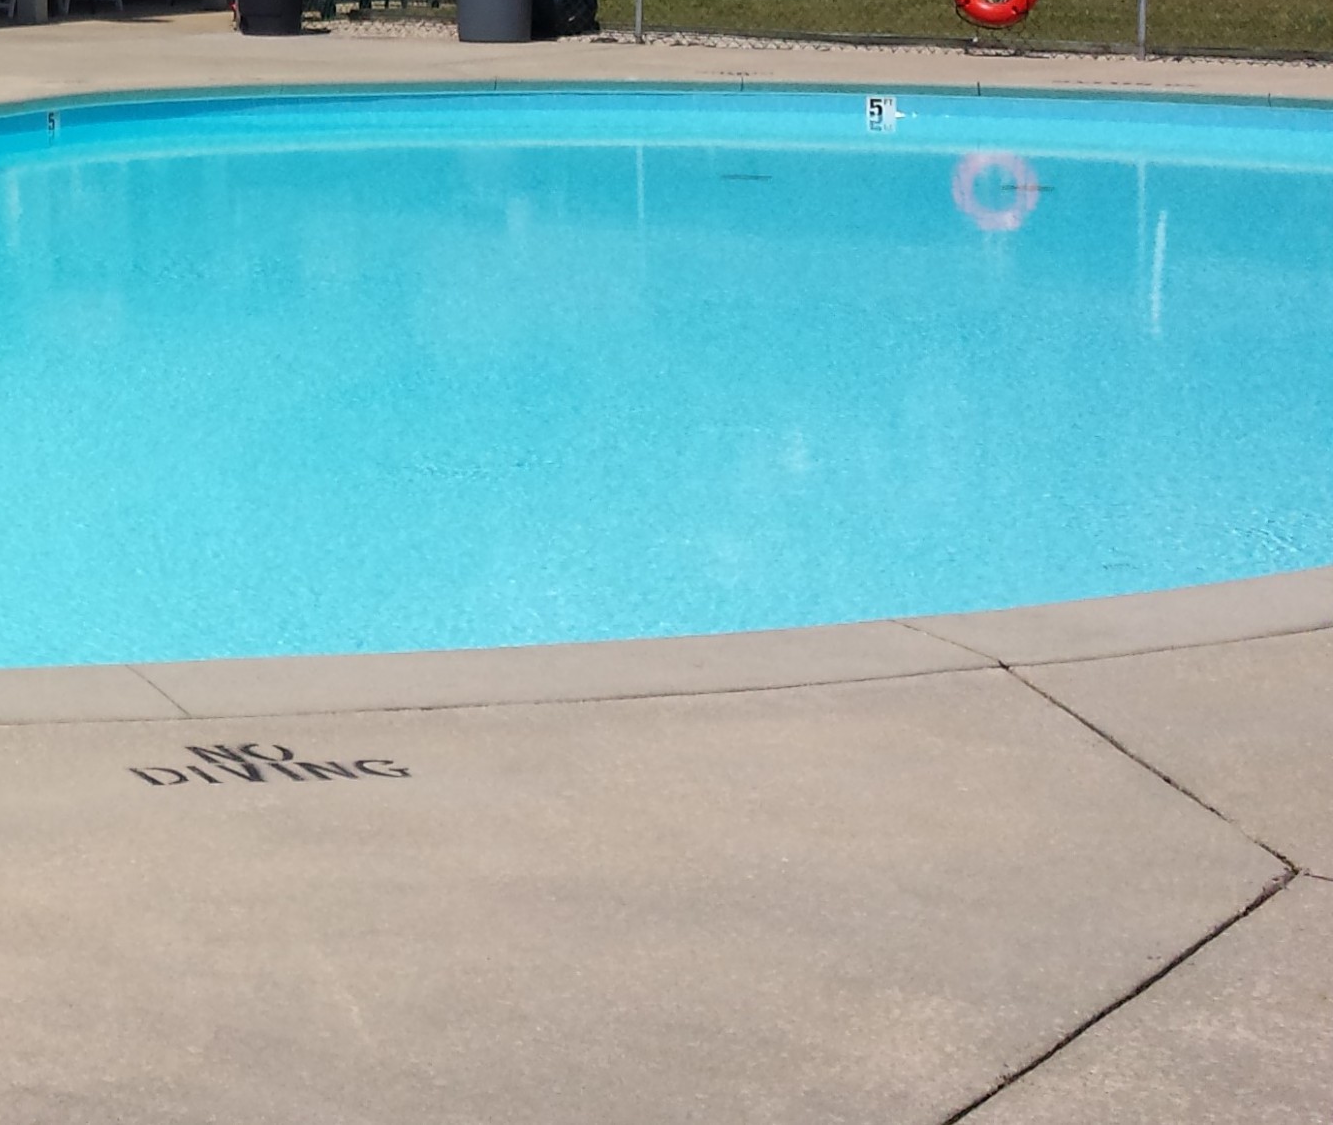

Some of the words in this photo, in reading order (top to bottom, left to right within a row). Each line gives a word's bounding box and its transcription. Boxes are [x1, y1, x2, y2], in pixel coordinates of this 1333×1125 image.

[869, 98, 883, 116] 5
[48, 112, 55, 131] 5
[185, 743, 294, 764] NO
[129, 760, 412, 786] DIVING
